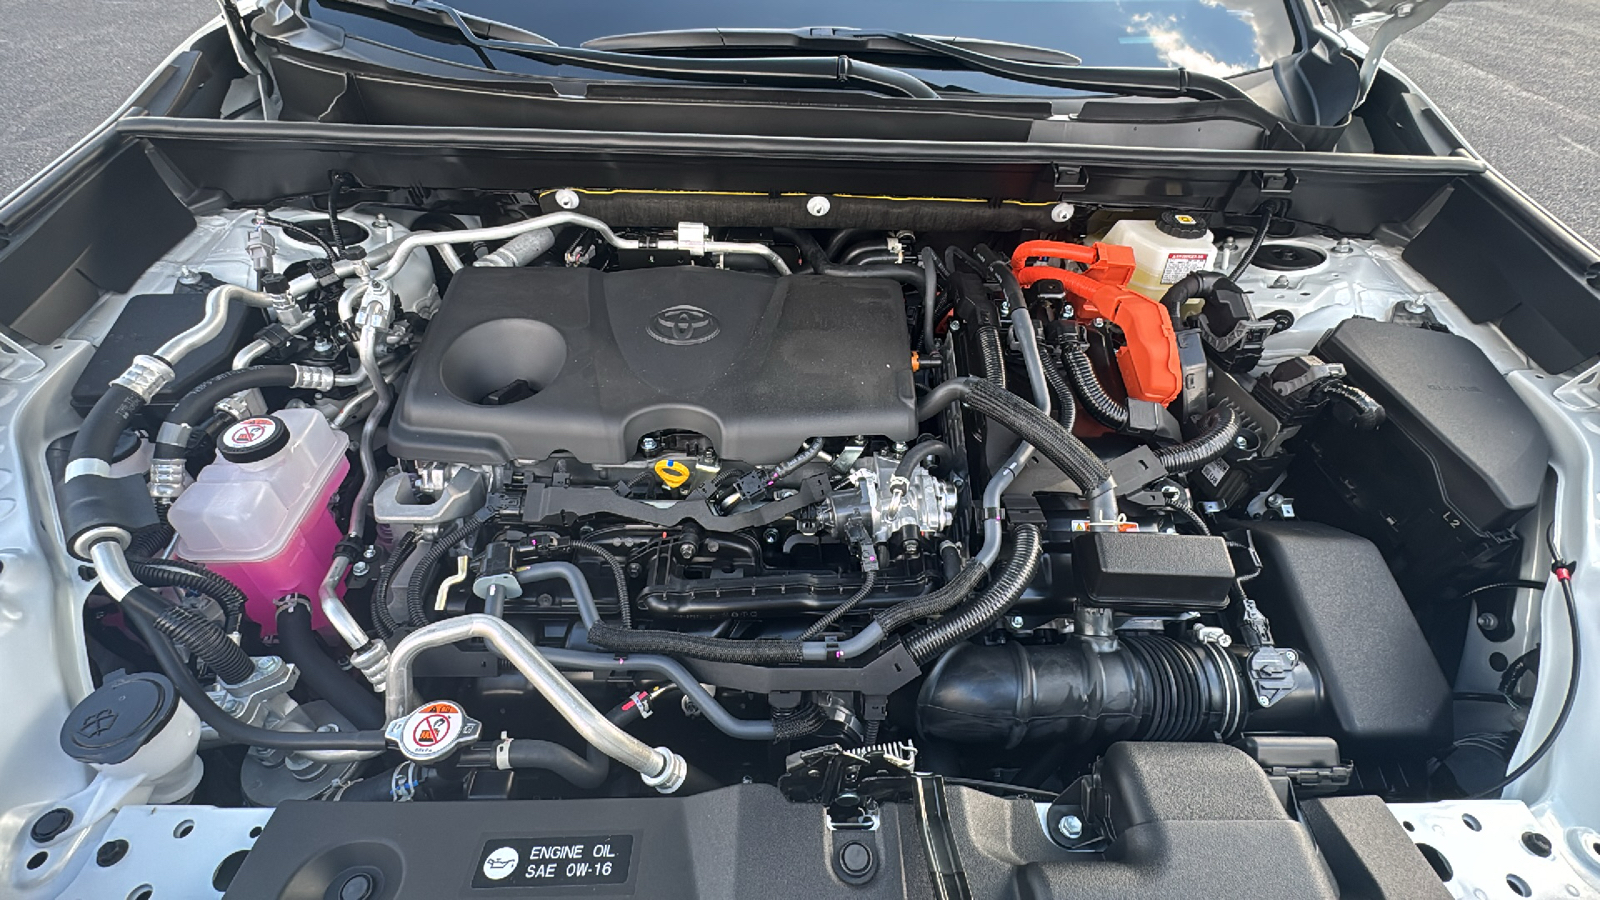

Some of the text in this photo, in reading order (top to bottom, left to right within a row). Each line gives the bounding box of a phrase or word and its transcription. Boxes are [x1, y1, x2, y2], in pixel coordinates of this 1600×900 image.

[529, 844, 616, 860] ENGINE OIL
[525, 861, 613, 878] SAE 0W-16
